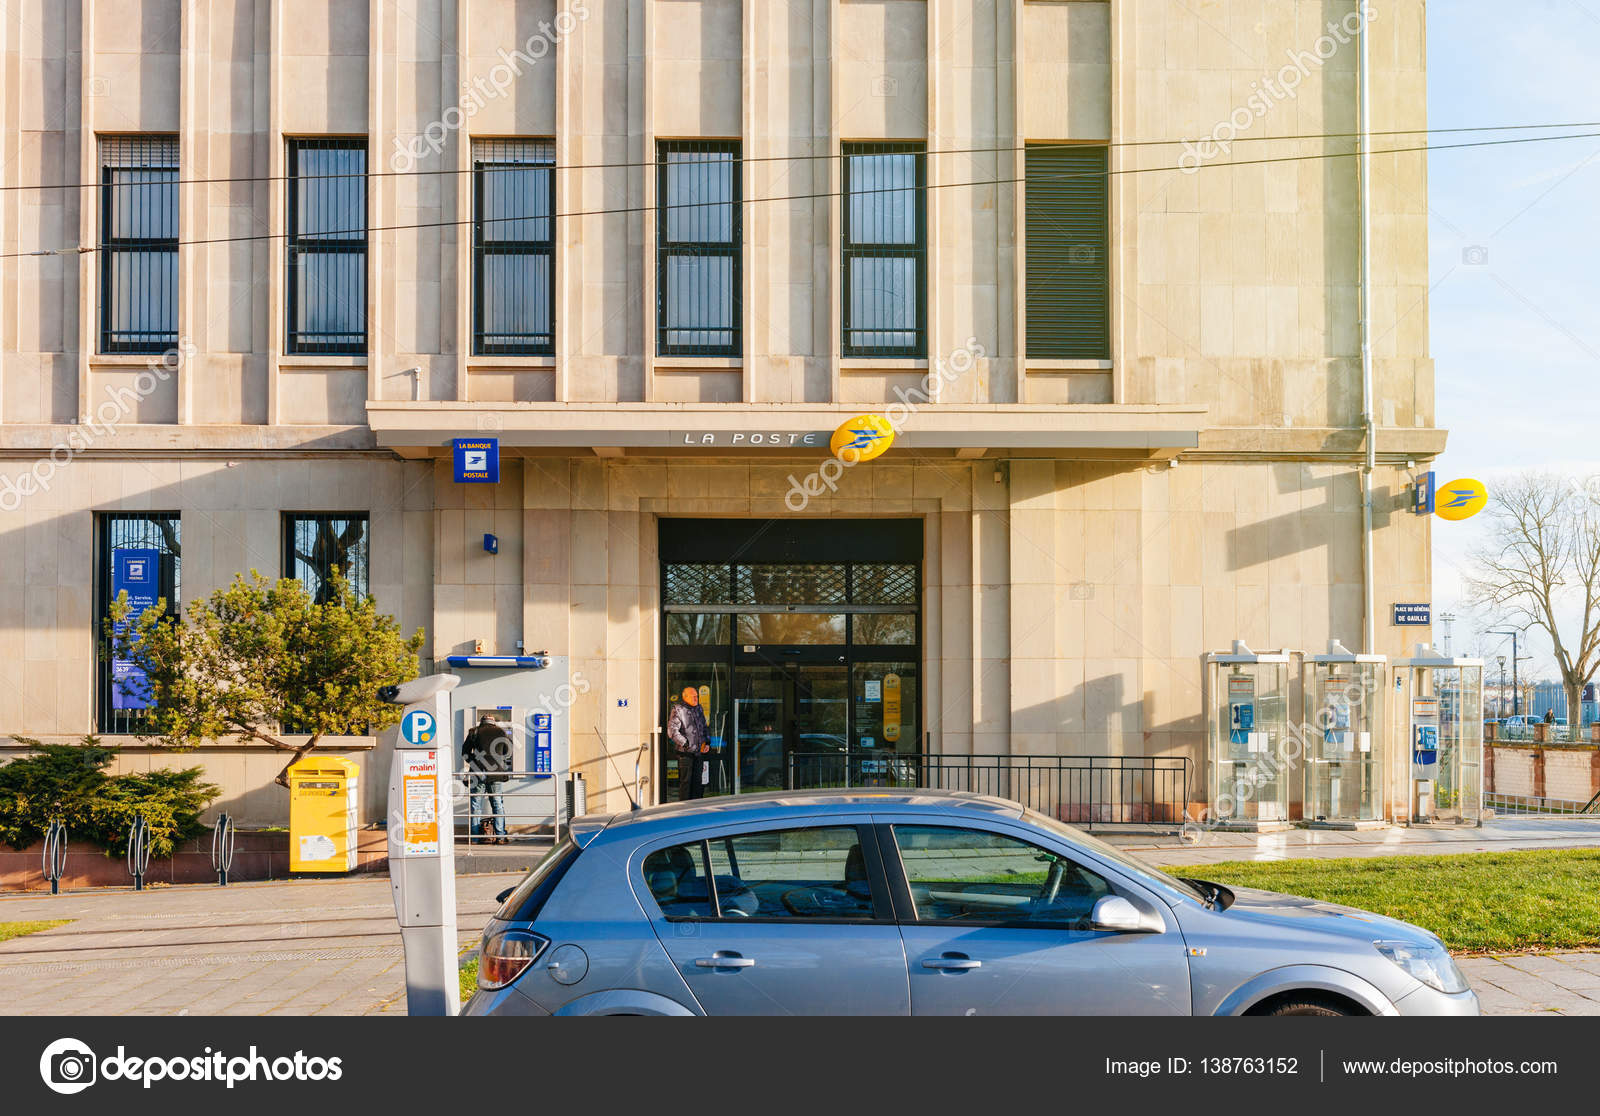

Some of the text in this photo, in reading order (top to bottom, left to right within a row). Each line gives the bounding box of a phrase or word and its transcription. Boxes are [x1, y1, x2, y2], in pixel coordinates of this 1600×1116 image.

[684, 433, 816, 444] LA POSTE
[412, 712, 432, 743] P
[409, 763, 435, 771] malin!
